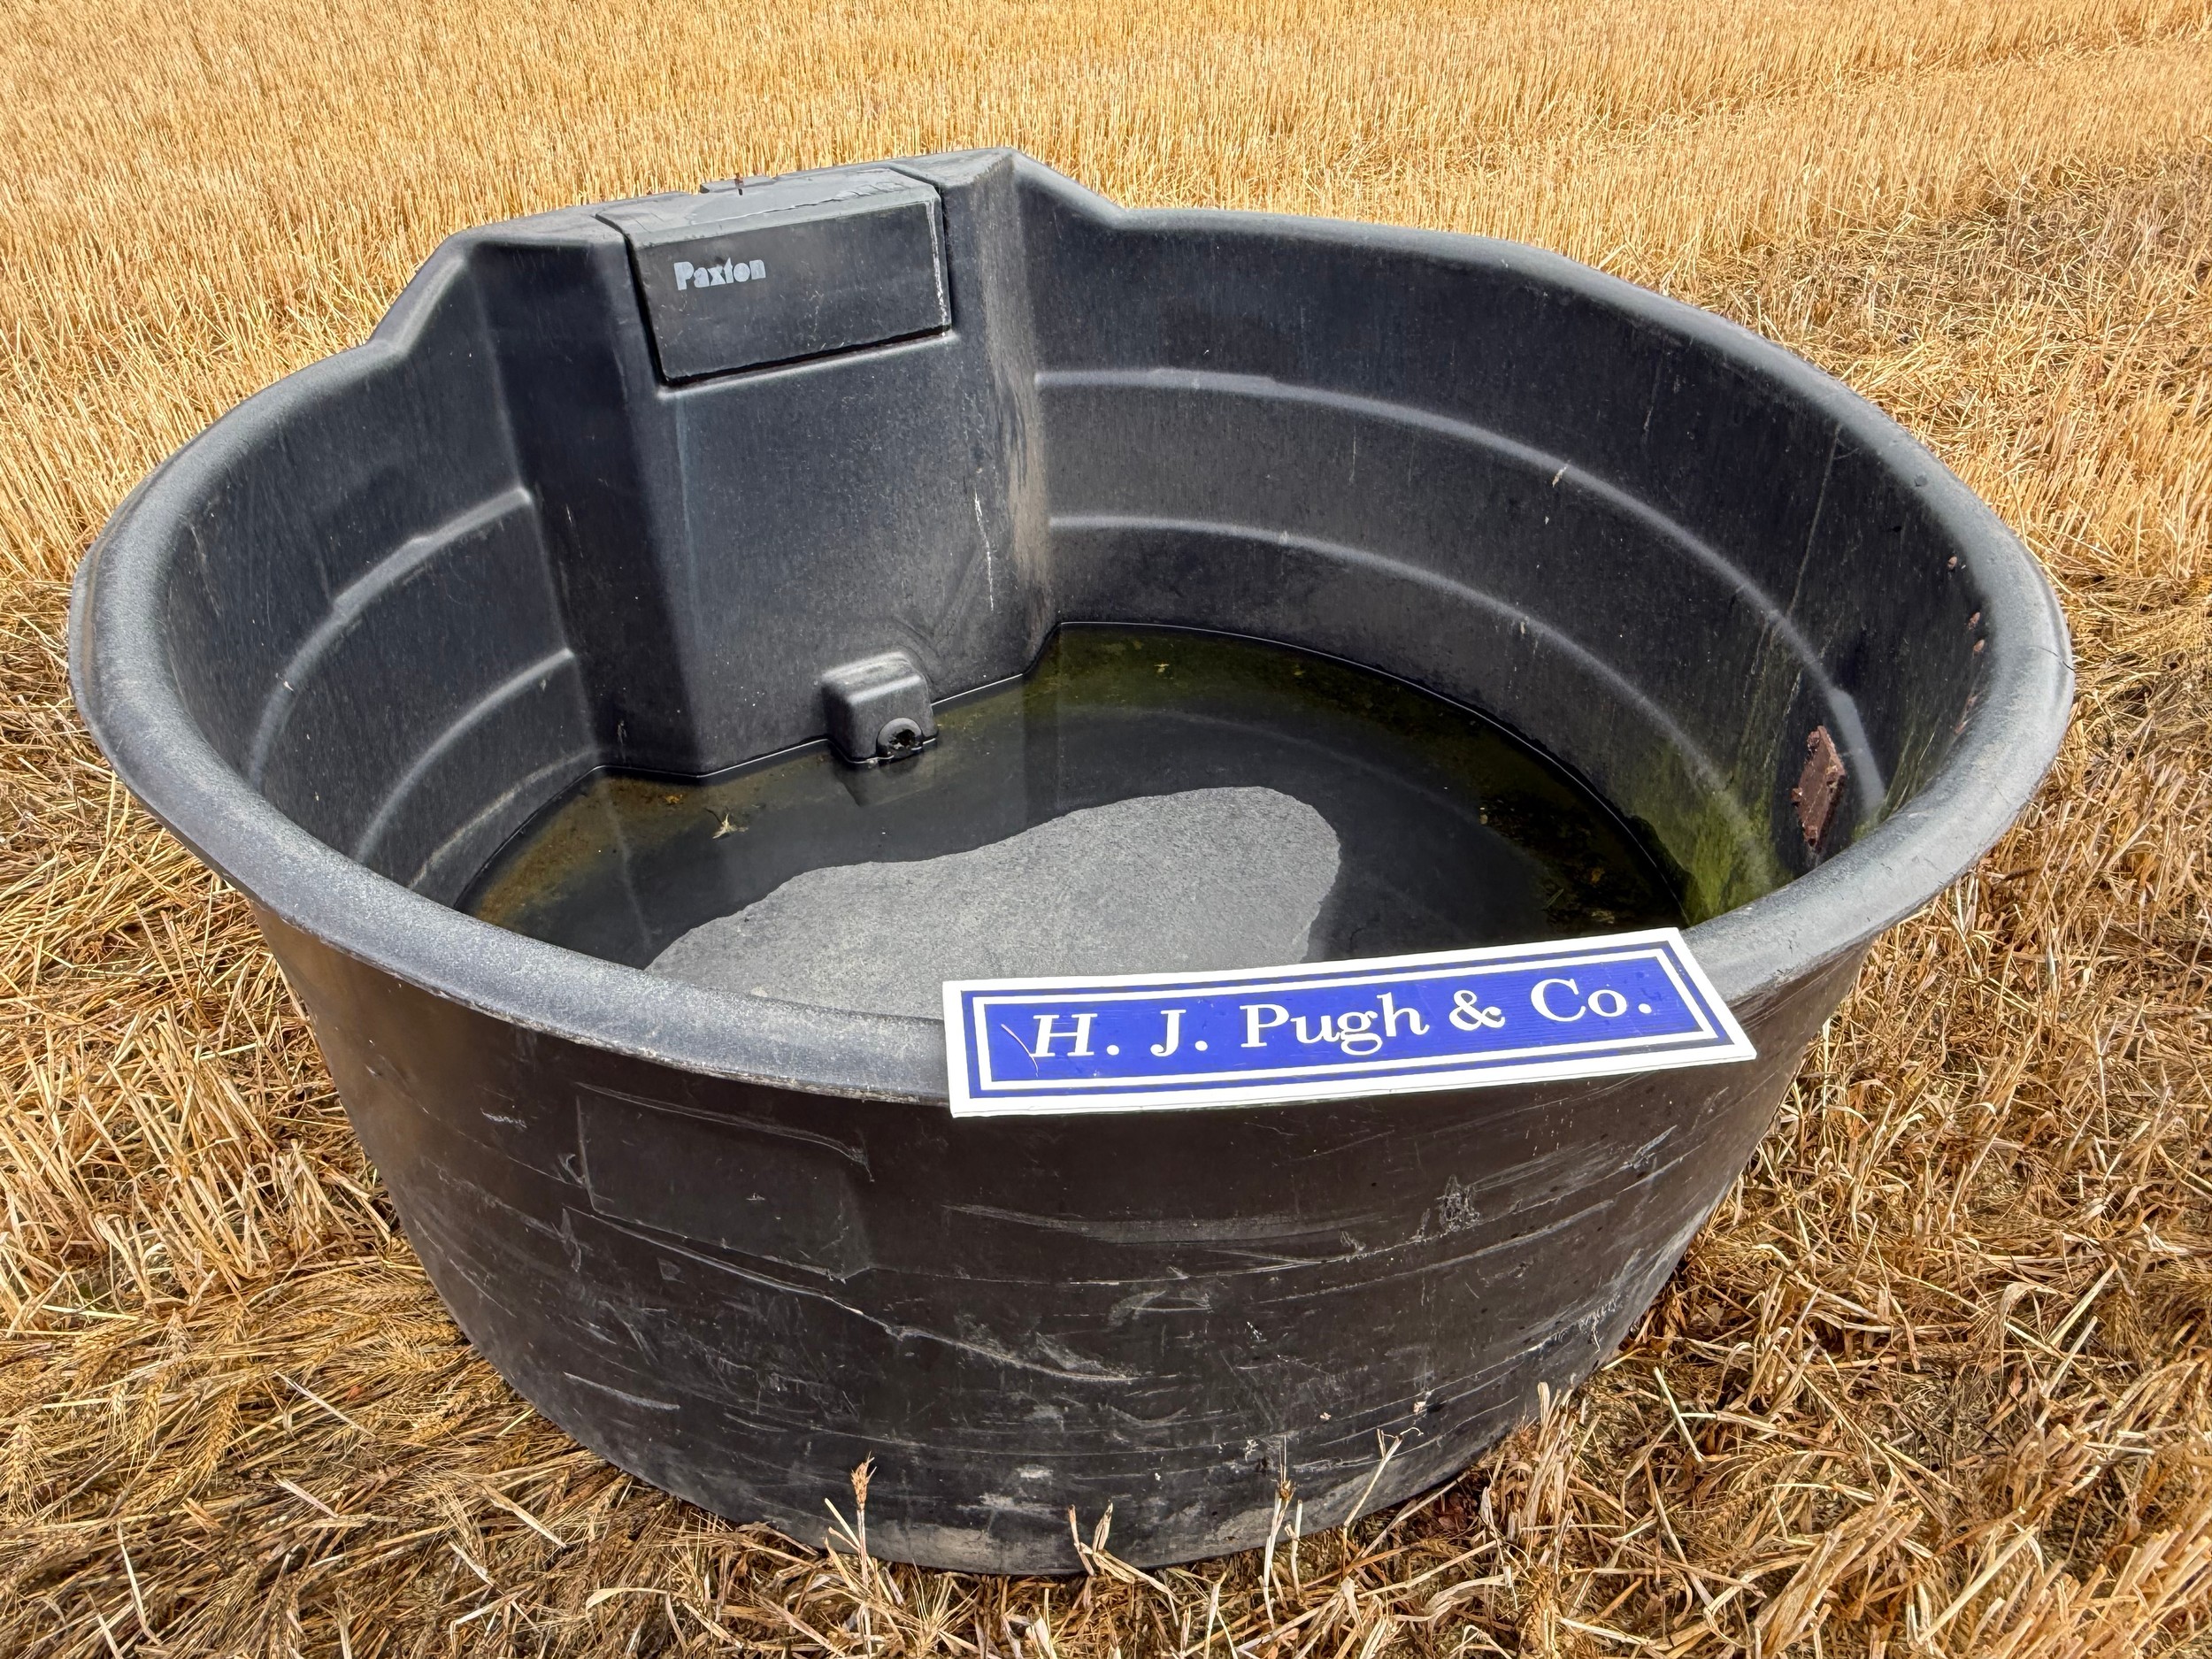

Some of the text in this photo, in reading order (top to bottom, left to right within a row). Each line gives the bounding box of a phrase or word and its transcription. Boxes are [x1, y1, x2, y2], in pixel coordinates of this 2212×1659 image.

[673, 257, 767, 291] Paxton
[1030, 978, 1653, 1058] H. J. Pugh & Co.
